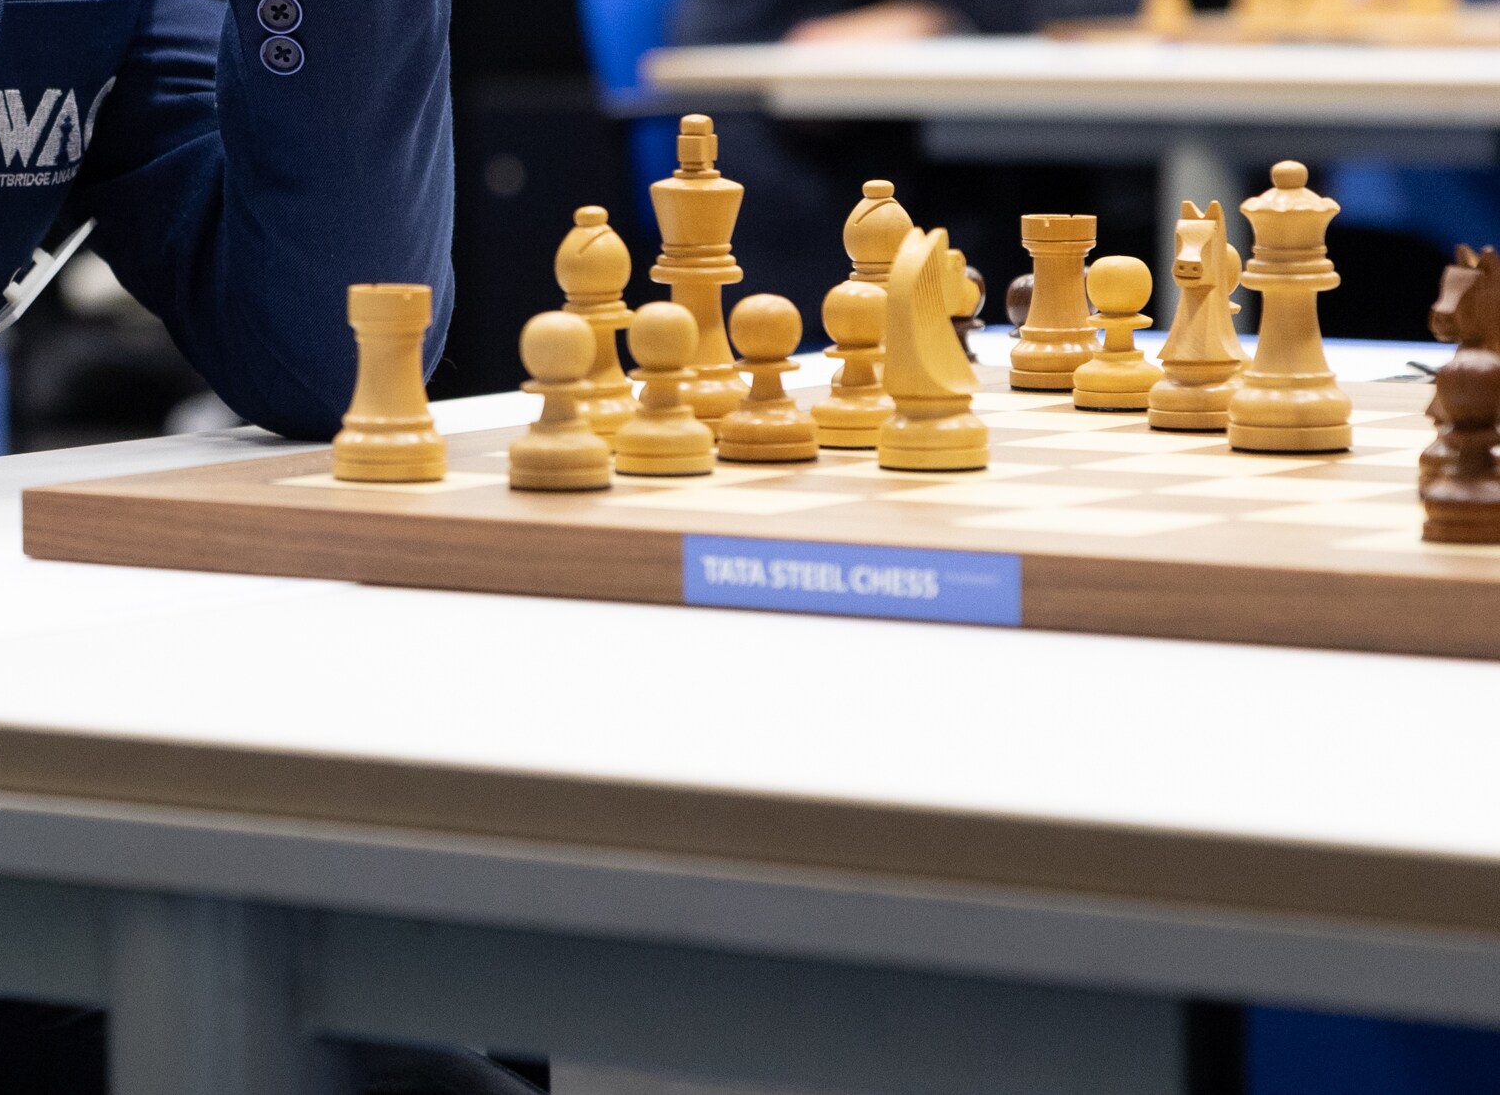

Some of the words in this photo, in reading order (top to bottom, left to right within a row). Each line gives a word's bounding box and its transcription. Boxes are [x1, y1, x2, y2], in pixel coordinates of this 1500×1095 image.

[702, 555, 766, 586] TATA
[768, 559, 849, 593] STEEL
[850, 564, 939, 600] CHESS
